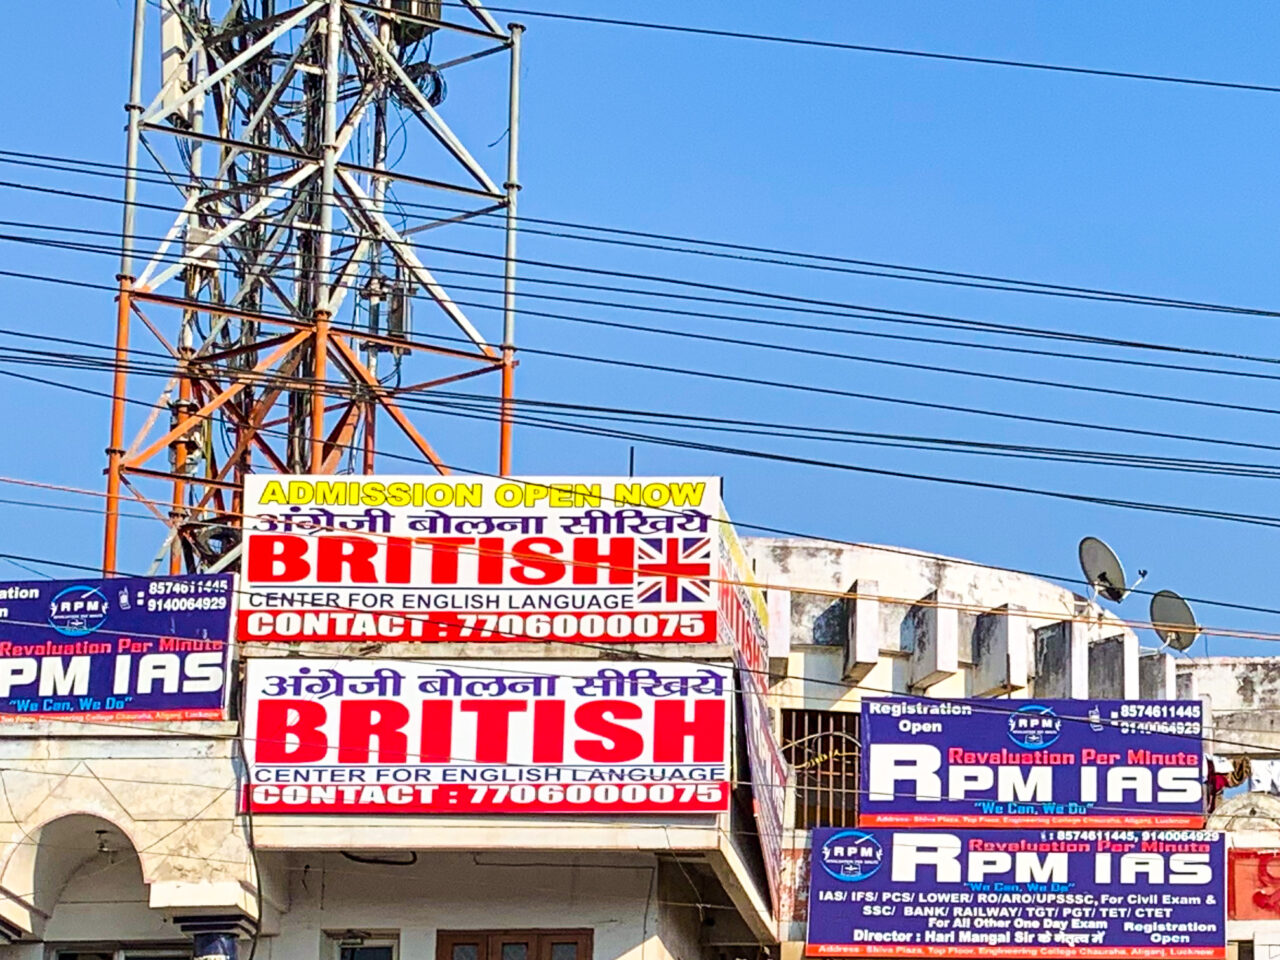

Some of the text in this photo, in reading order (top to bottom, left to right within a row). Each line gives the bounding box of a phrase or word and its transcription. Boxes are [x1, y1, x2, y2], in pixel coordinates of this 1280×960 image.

[258, 481, 706, 507] ADMISSION OPEN NOW
[248, 535, 634, 585] BRITISH
[249, 592, 634, 609] CENTER FOR ENGLISH LANGUAGE
[247, 612, 704, 638] CONTACT 7706000075
[113, 652, 223, 695] IAS
[262, 667, 727, 699] अंग्रेजी बोलना सीखिये
[870, 702, 972, 716] Registration
[255, 699, 725, 763] BRITISH
[899, 720, 942, 735] Open
[1081, 748, 1121, 765] Per
[869, 744, 1202, 802] RPM IAS
[252, 785, 722, 804] CONTACT 7706000075
[891, 833, 1213, 884] RPM IAS
[819, 891, 1216, 904] IAS/ IFS/ PCS/ LOWER/ For Exam &
[904, 906, 1173, 918] BANK/ RAILWAY/ TGT/ PGT/ TET/ CTET
[928, 918, 1108, 930] For One Day Exam
[1124, 922, 1216, 934] Registration
[1150, 933, 1190, 944] Open
